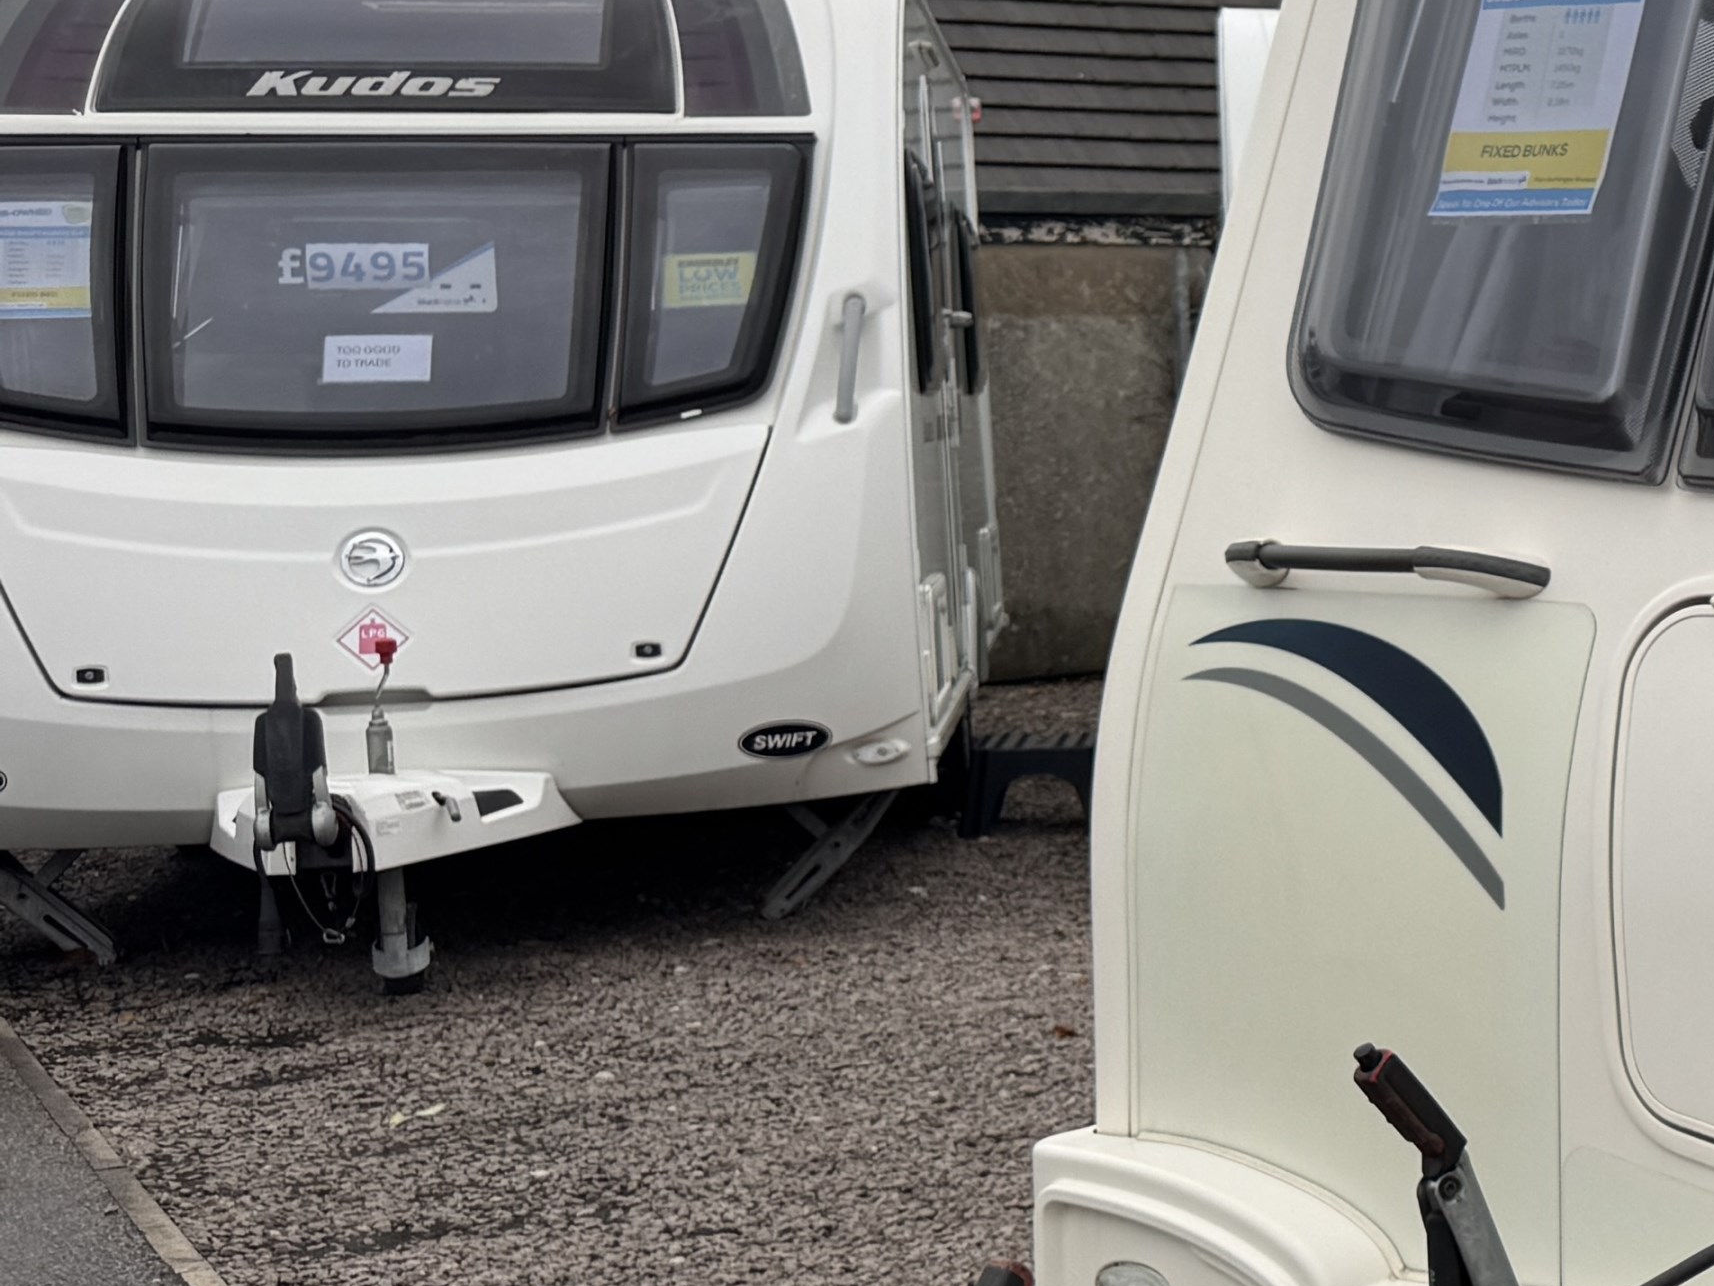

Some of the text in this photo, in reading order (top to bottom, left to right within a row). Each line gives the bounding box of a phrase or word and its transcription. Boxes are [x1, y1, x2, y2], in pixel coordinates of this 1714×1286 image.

[246, 70, 501, 98] Kudos
[1480, 143, 1569, 159] FIXED BUNKS
[278, 247, 426, 285] £9495
[361, 627, 386, 639] LPG
[753, 730, 818, 751] SWIFT
